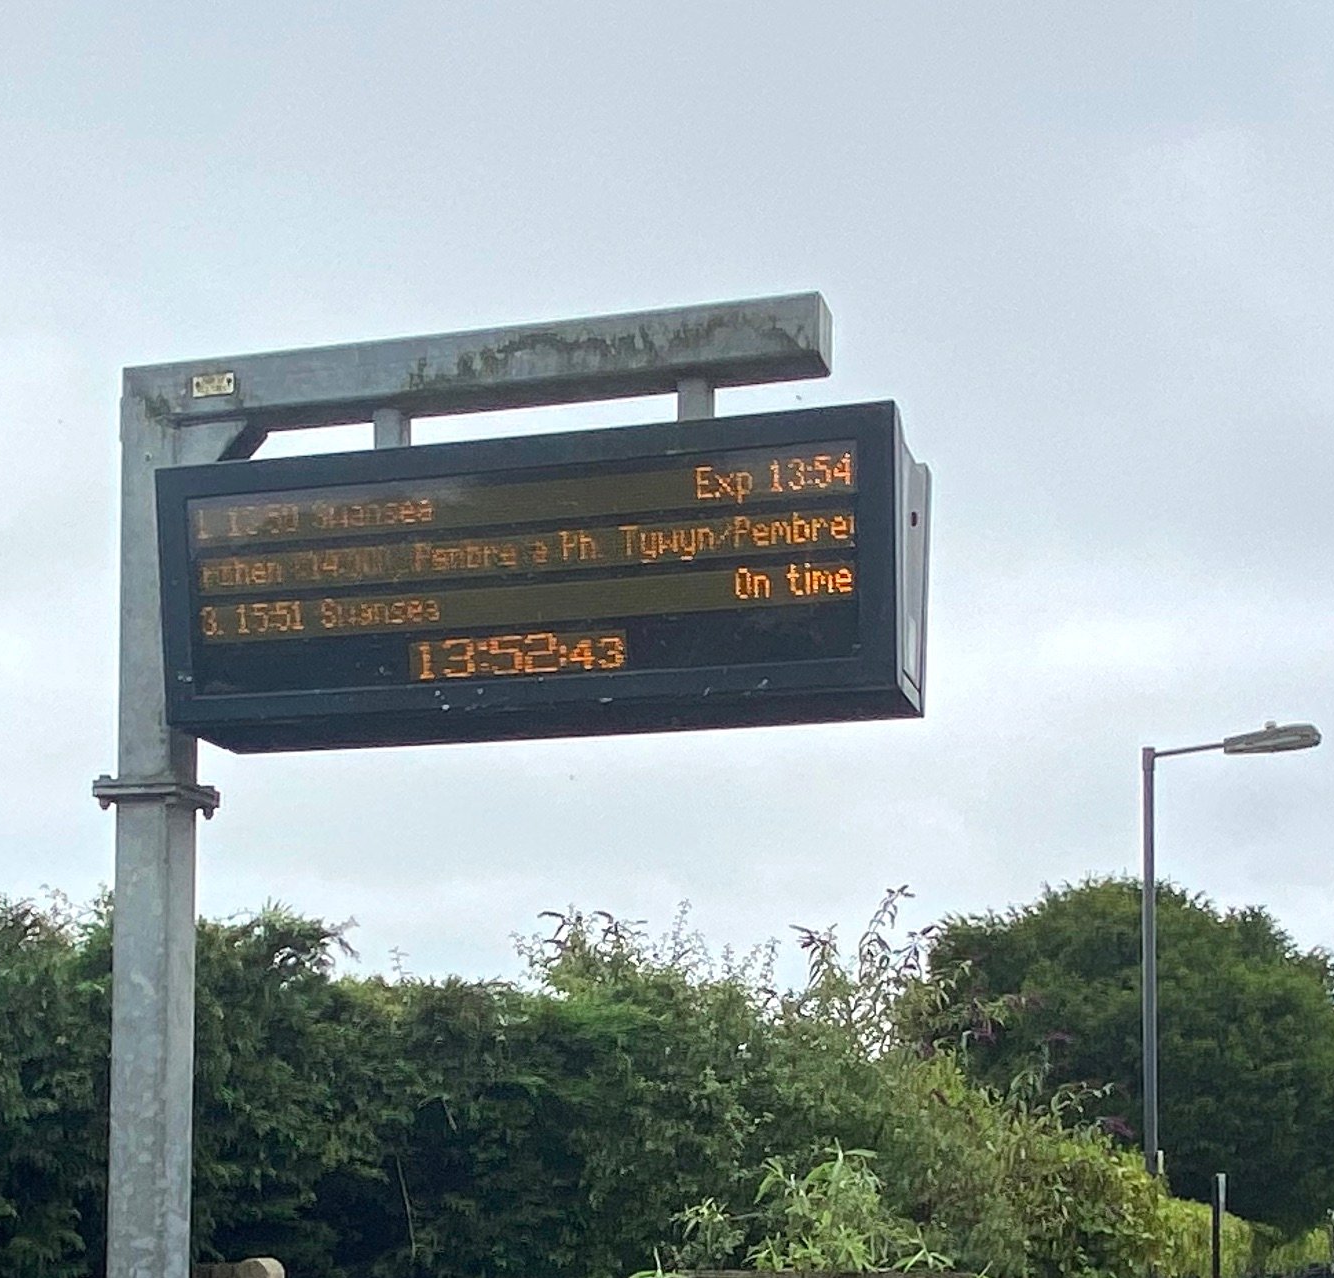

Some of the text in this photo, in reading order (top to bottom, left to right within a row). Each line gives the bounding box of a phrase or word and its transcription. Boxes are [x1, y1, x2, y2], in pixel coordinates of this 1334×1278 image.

[695, 465, 753, 504] Exp
[769, 451, 853, 493] 13:54
[734, 565, 771, 600] On
[786, 562, 853, 597] time
[419, 632, 626, 681] 13:52:43
